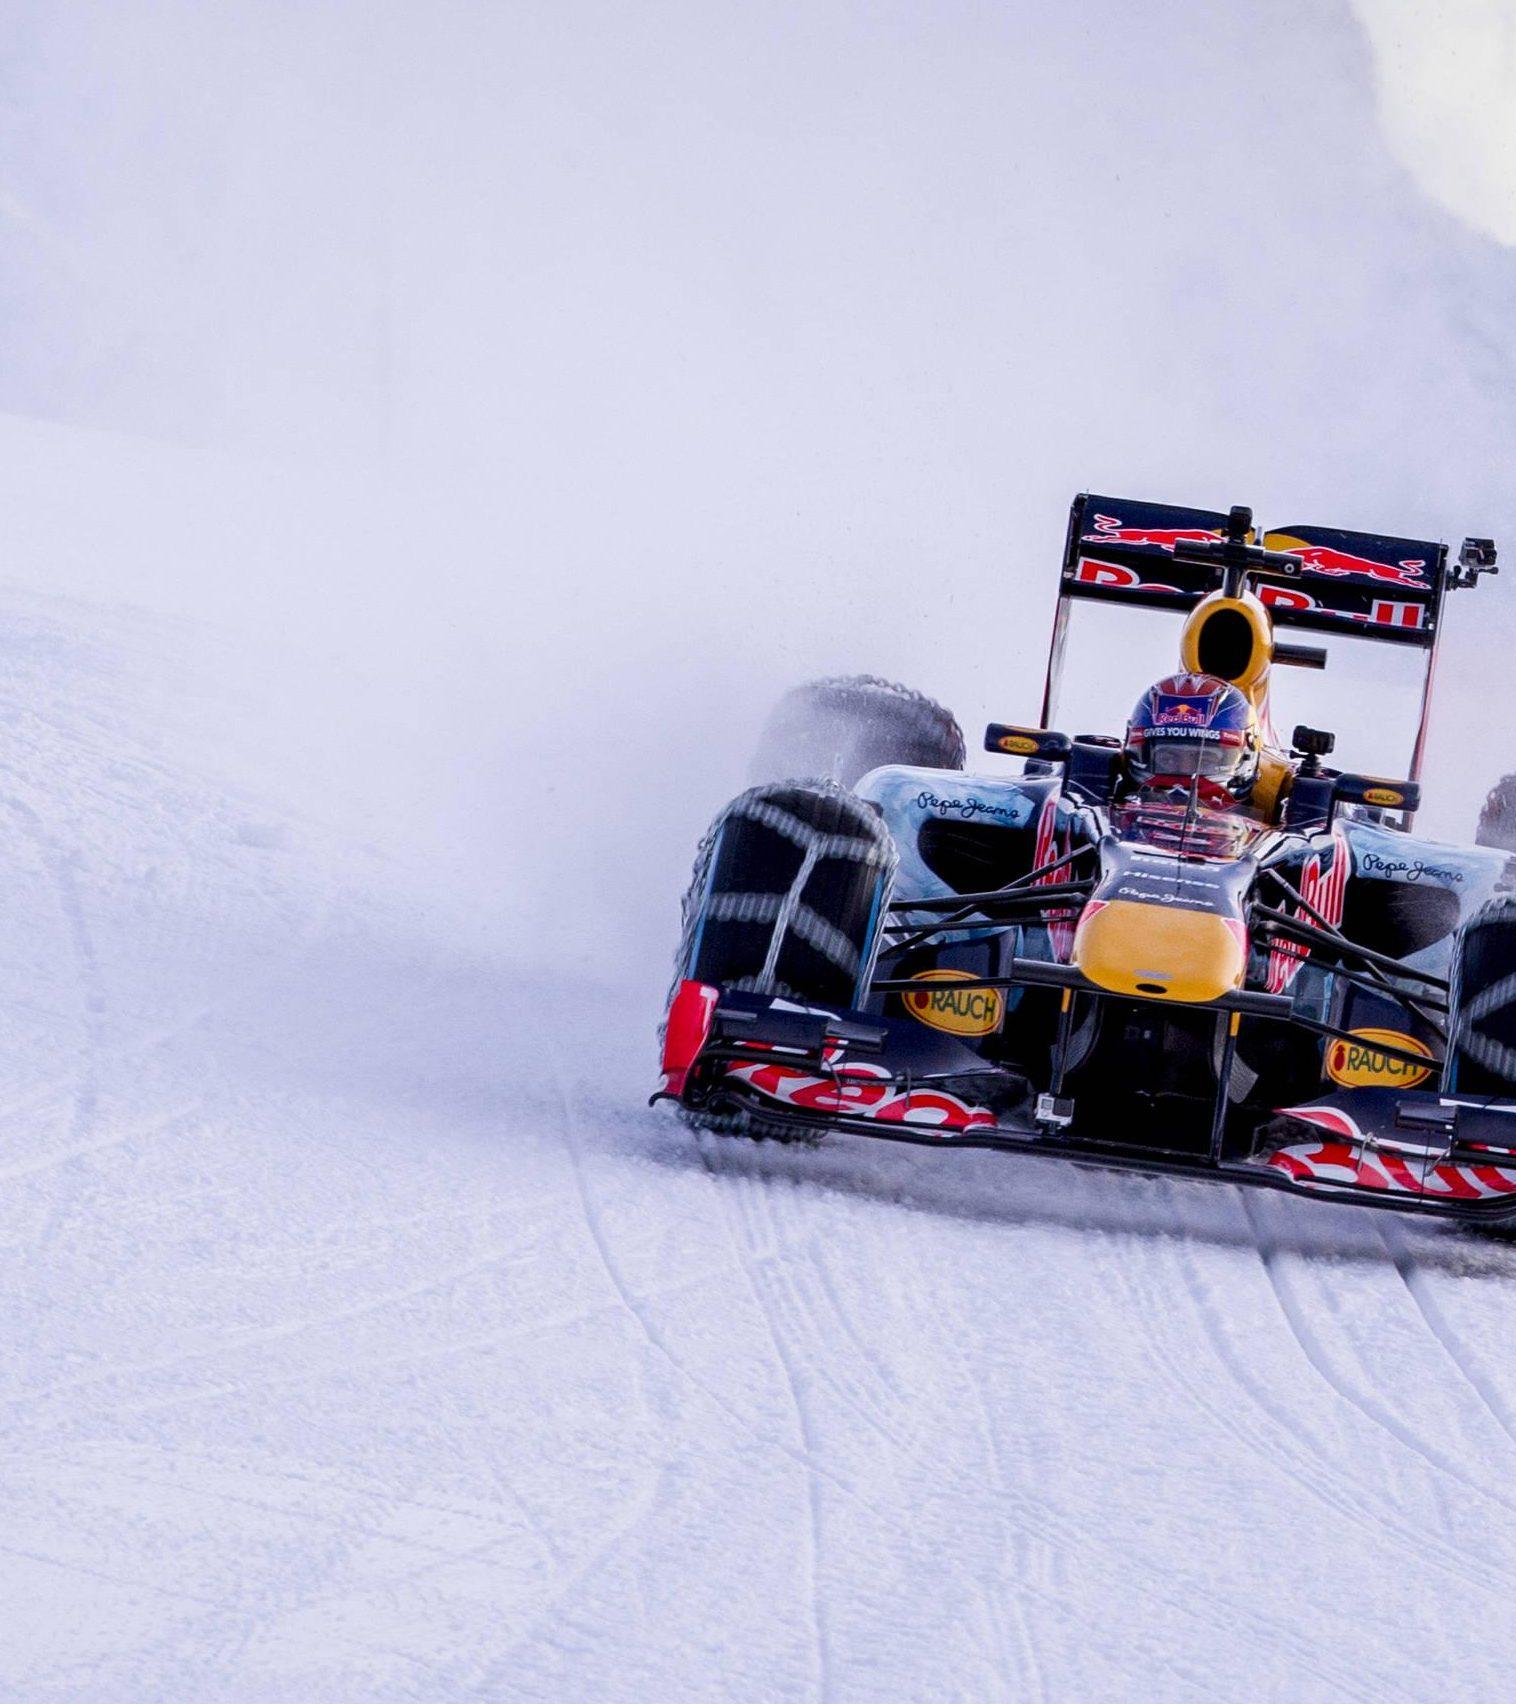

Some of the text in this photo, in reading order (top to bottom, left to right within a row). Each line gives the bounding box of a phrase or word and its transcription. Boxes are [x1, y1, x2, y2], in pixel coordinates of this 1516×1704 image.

[1144, 727, 1166, 738] GIVES
[1167, 727, 1187, 737] YOU
[1187, 727, 1220, 740] WINGS
[917, 791, 1021, 819] Pepe Jeans
[1363, 853, 1464, 882] Pepe Jeans
[930, 987, 996, 1022] RAUCH
